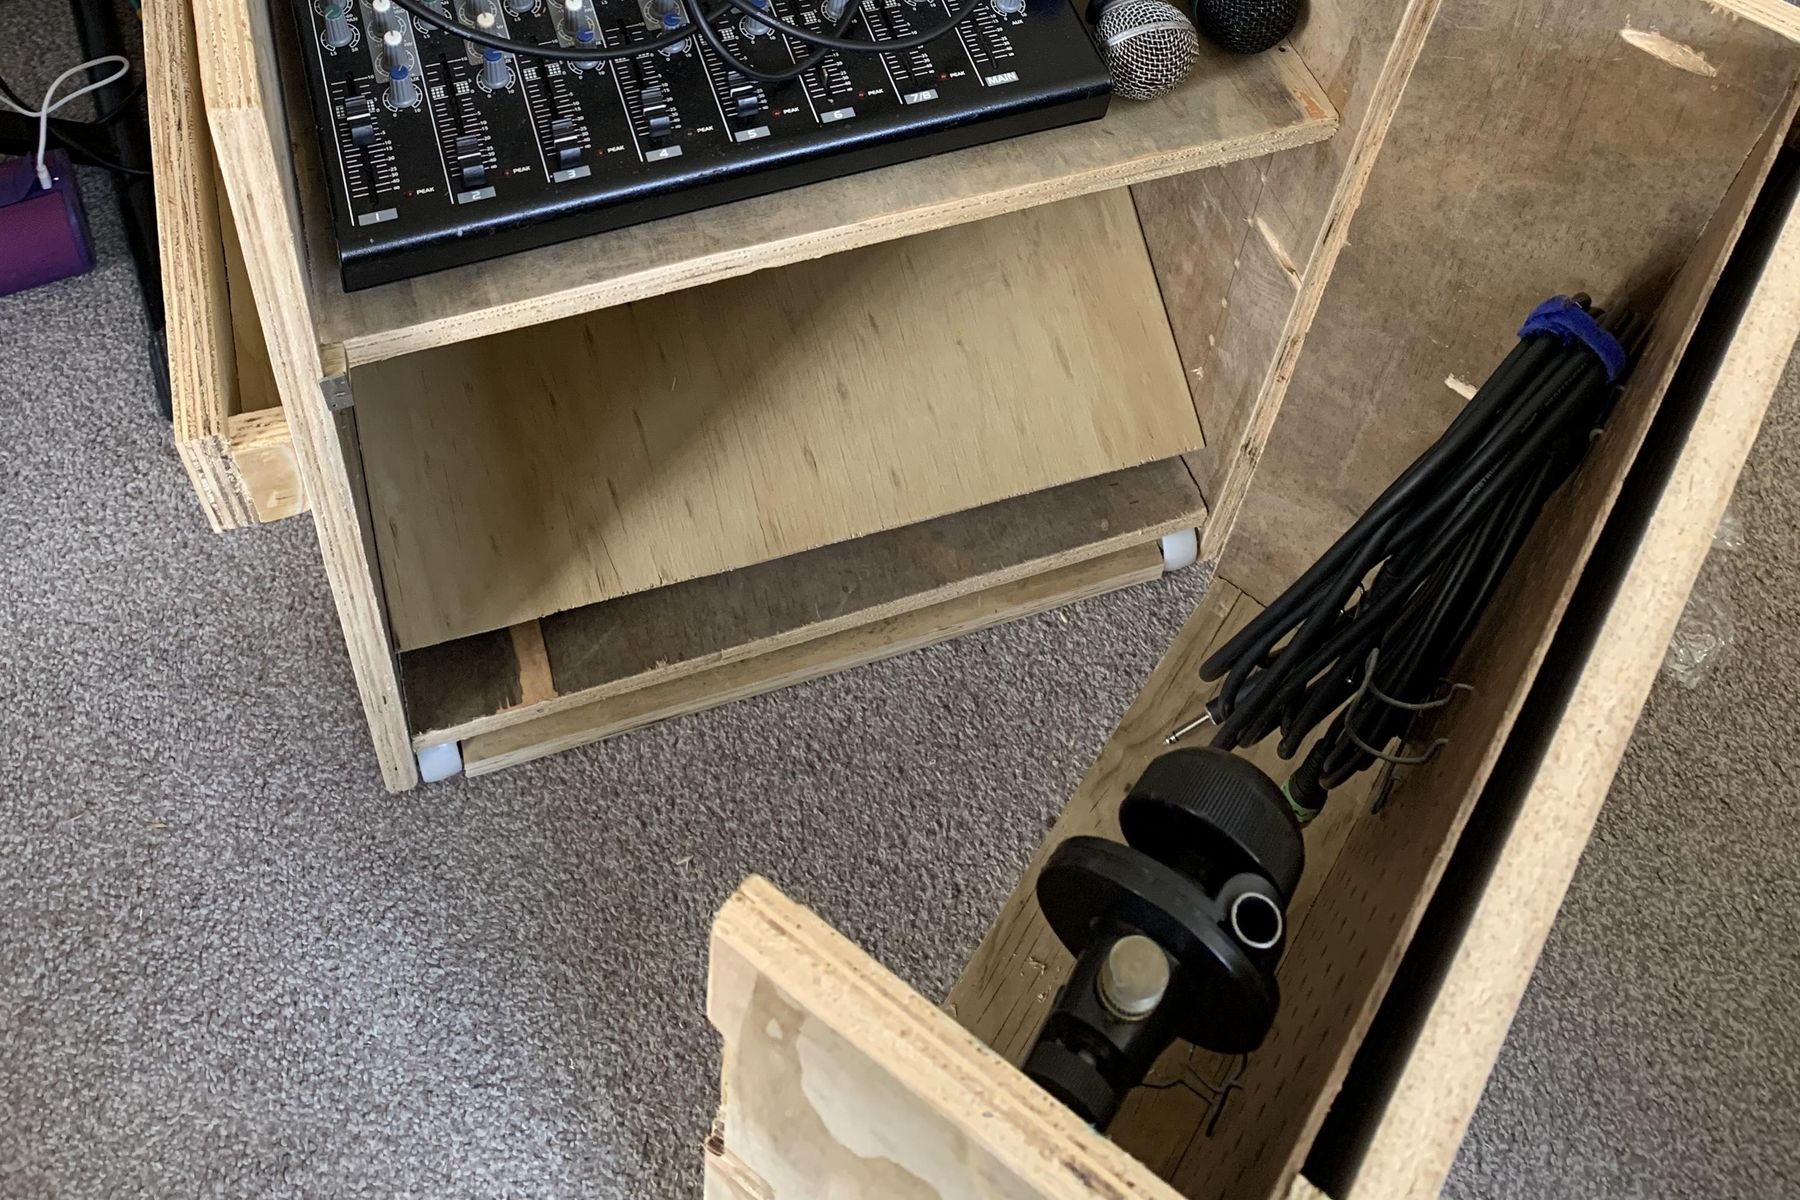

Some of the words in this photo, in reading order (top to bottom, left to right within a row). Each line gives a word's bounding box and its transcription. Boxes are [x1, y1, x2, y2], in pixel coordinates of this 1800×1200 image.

[949, 70, 966, 78] PEAK
[988, 72, 1017, 86] MAIN
[867, 88, 884, 96] PEAK
[911, 90, 932, 102] 7/8
[783, 106, 800, 115] PEAK
[833, 110, 843, 119] 6
[696, 125, 714, 133] PEAK
[747, 129, 757, 138] 5
[607, 144, 625, 153] PEAK
[659, 149, 669, 157] 4
[512, 165, 531, 174] PEAK
[568, 170, 577, 178] 3
[416, 186, 435, 195] PEAK
[471, 191, 482, 200] 2
[375, 212, 380, 221] 1
